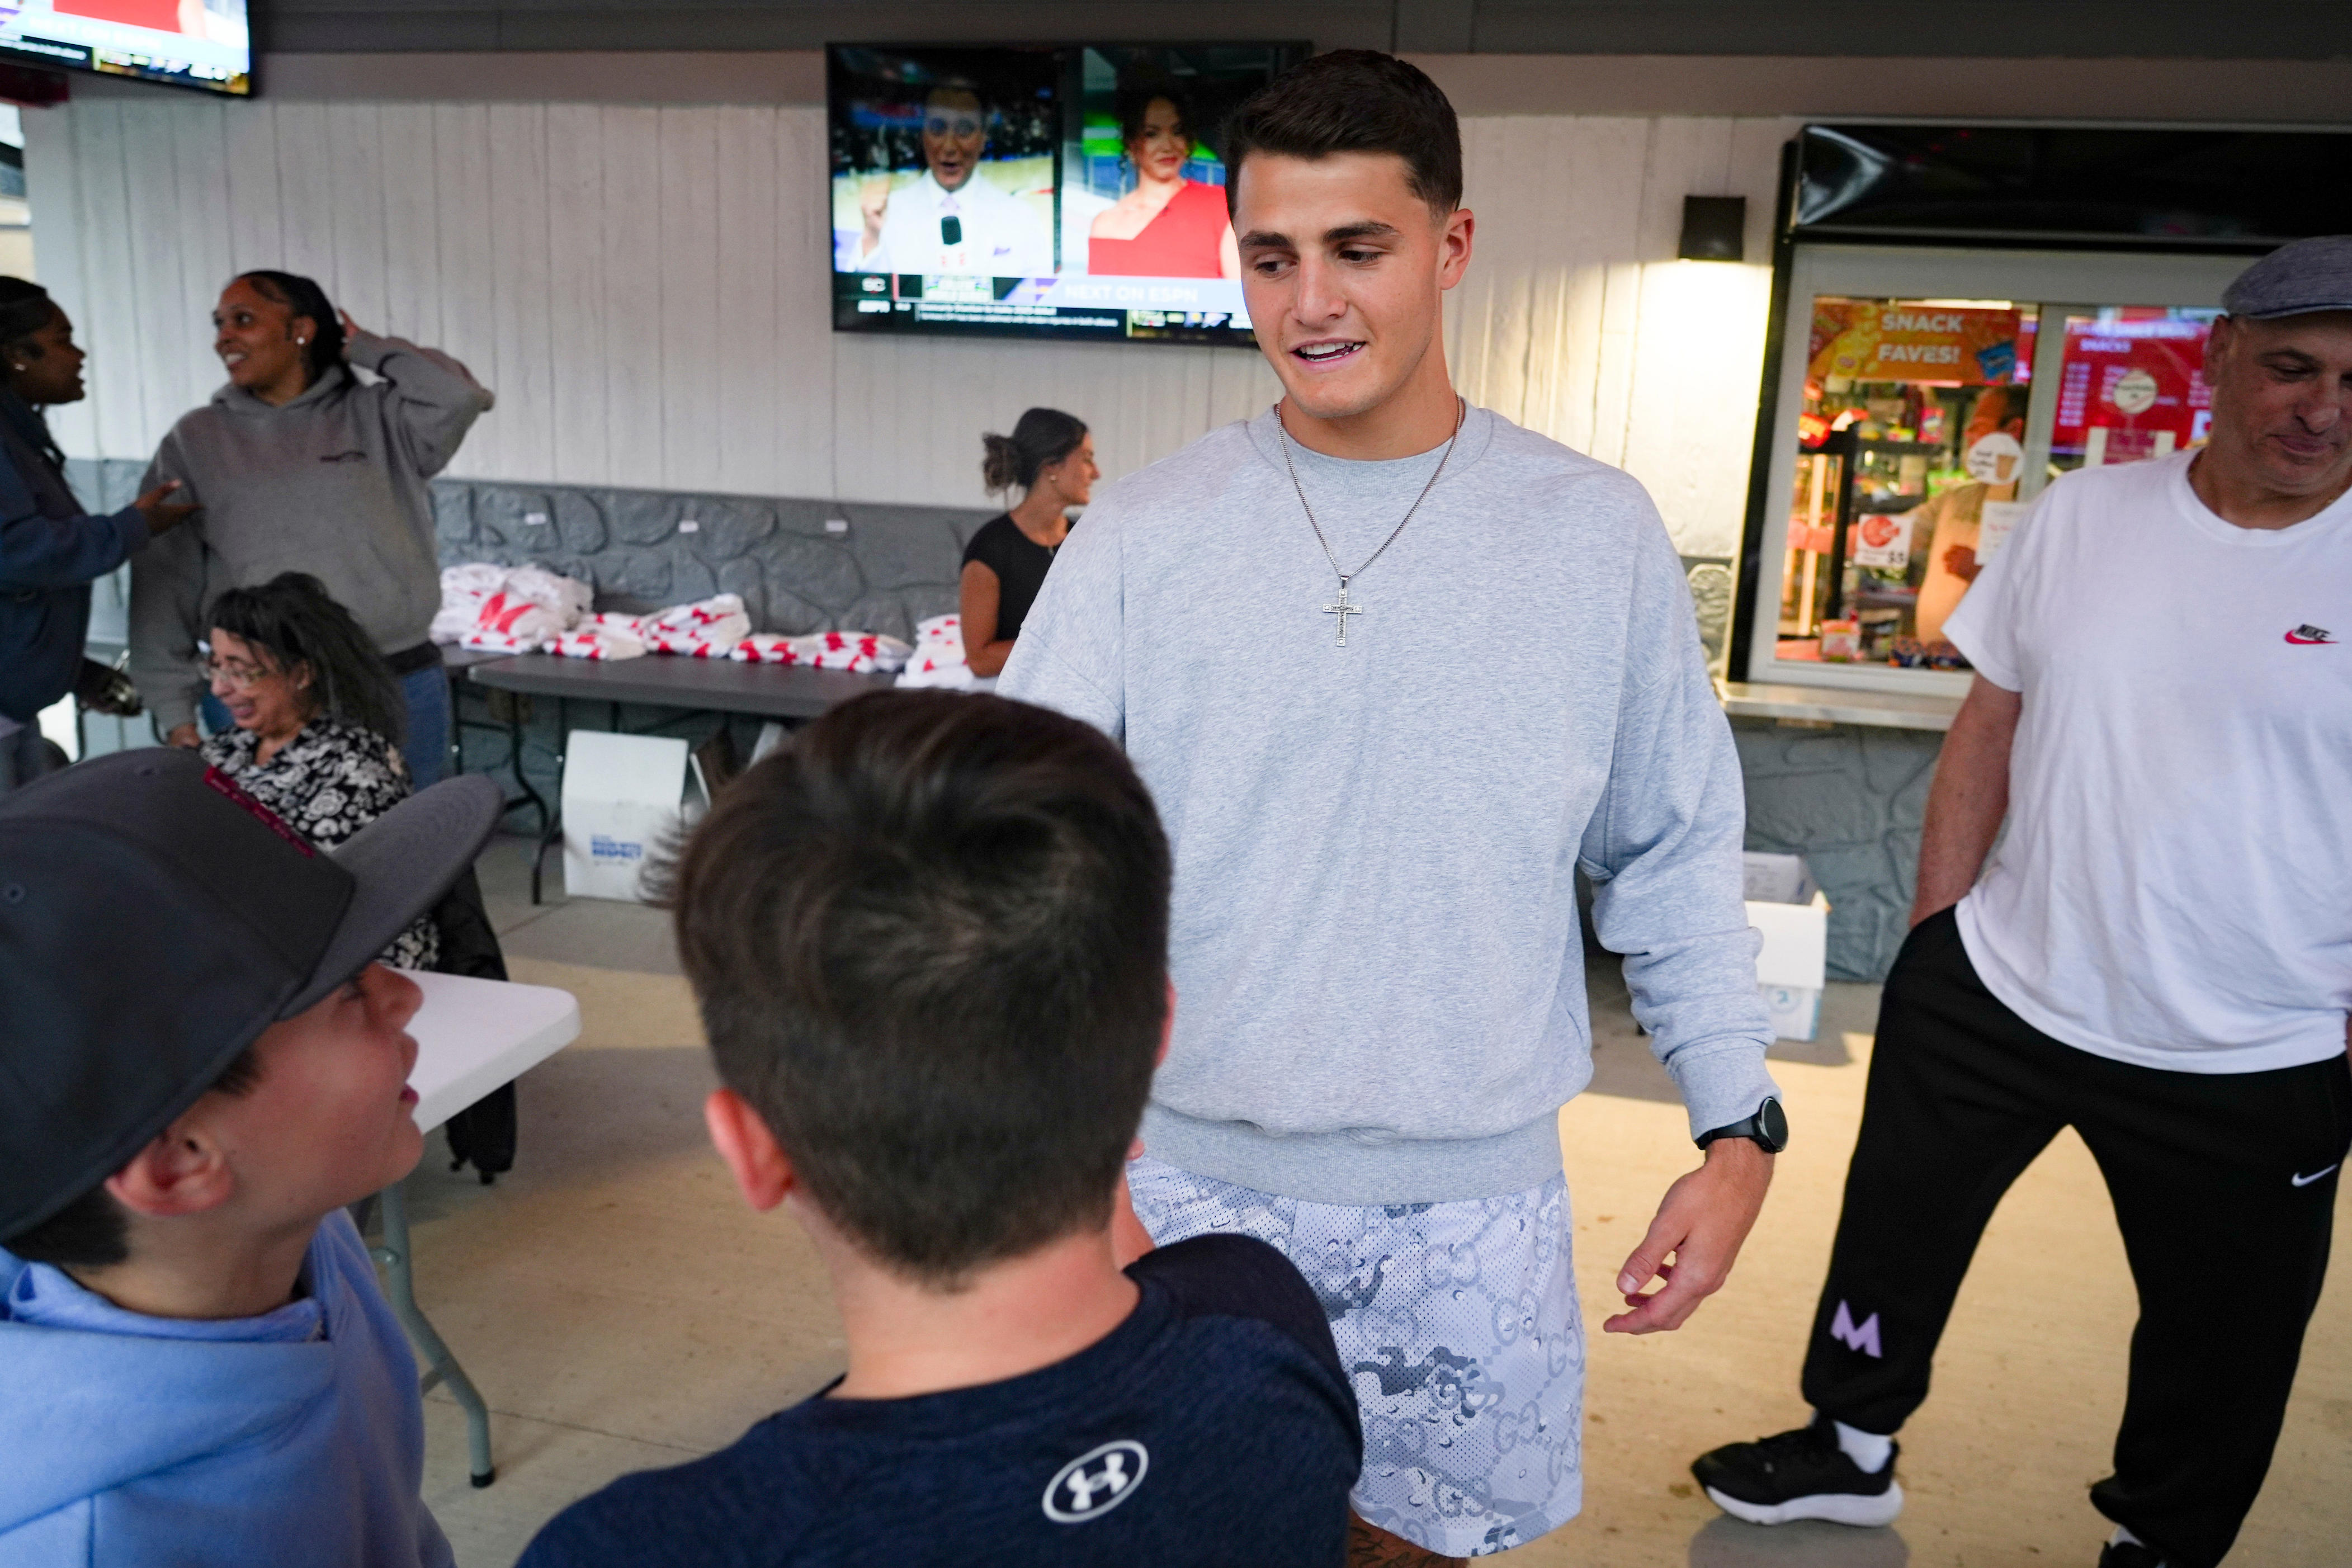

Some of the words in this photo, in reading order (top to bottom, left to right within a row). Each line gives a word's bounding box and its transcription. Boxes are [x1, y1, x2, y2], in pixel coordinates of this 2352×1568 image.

[1064, 284, 1113, 300] NEXT
[1116, 285, 1145, 301] ON
[1148, 285, 1199, 303] ESPN
[1881, 313, 1964, 333] SNACK
[1877, 343, 1962, 364] FAVES!
[2294, 624, 2330, 642] NIKE
